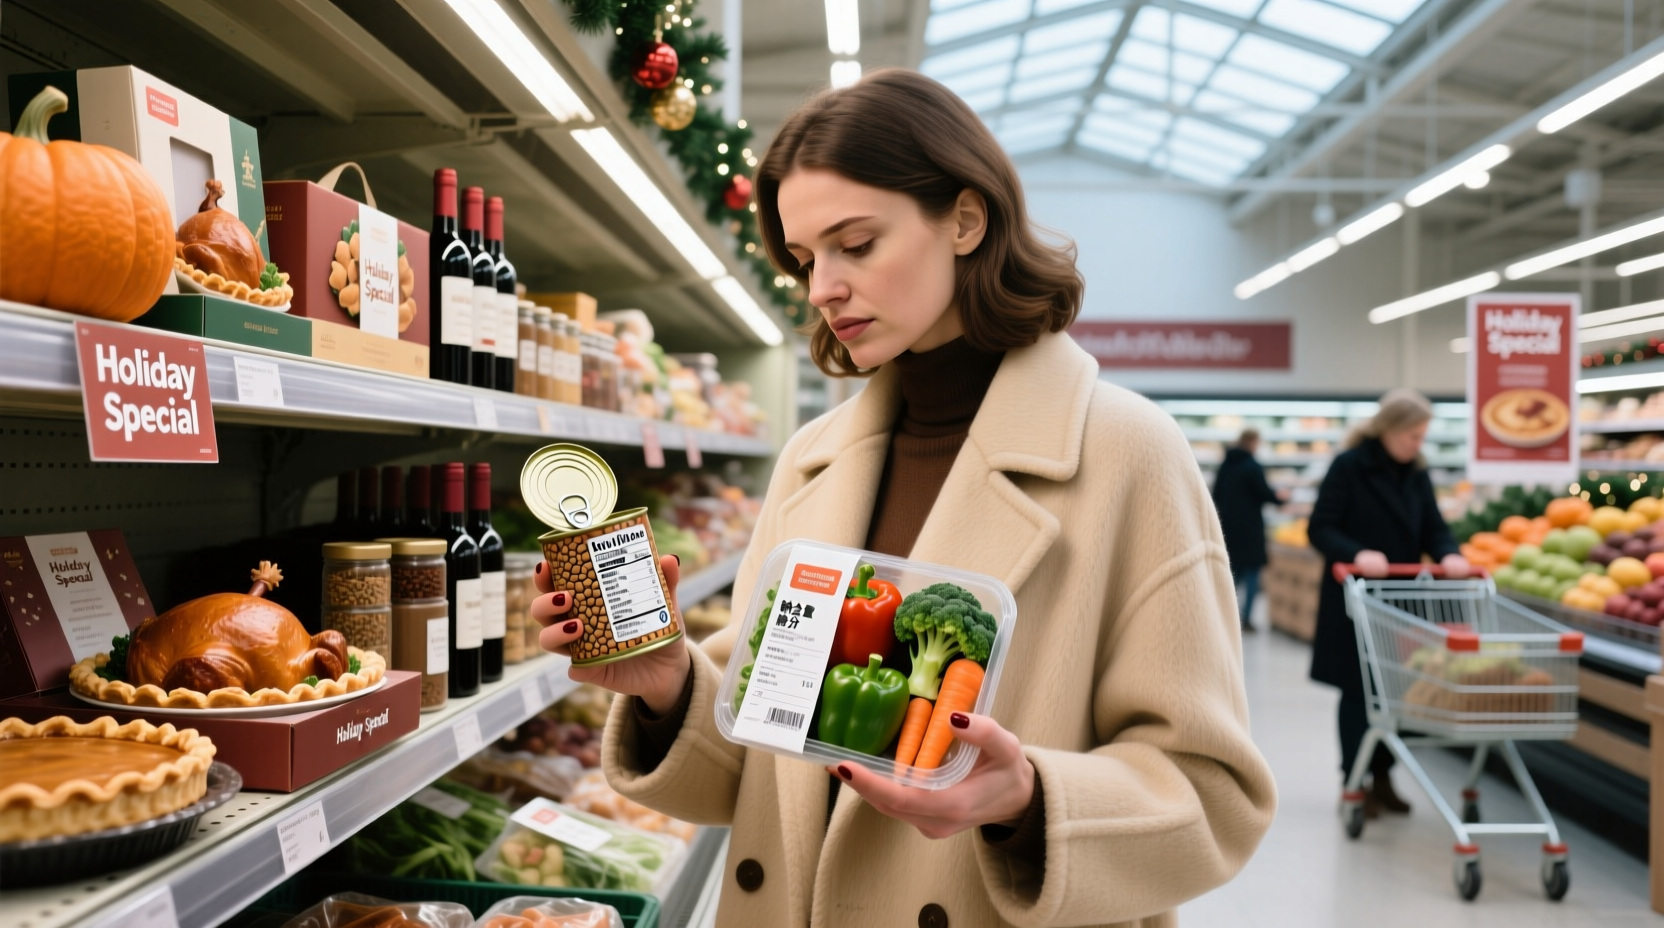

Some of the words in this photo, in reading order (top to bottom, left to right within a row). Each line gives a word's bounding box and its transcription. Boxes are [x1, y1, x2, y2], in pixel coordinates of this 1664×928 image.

[1484, 308, 1563, 336] Holiday
[1486, 330, 1562, 360] Special
[95, 343, 196, 400] Holiday
[103, 391, 200, 442] Special
